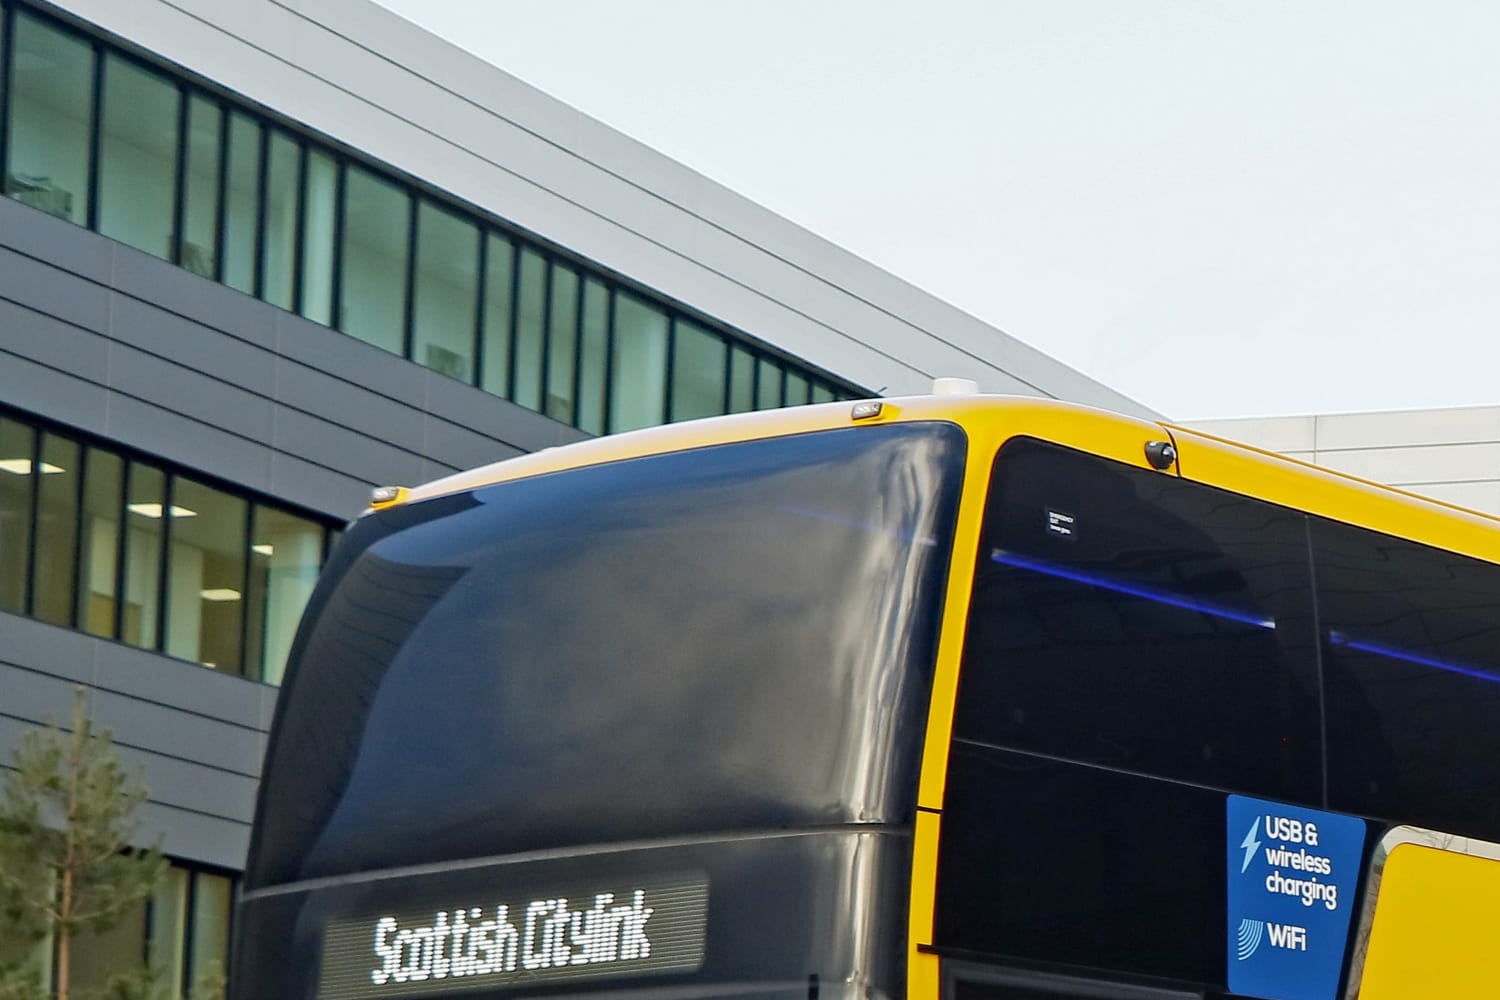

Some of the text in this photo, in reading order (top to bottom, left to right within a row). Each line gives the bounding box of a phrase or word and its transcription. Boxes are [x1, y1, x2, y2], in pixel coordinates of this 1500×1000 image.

[1265, 815, 1318, 846] USB &
[1265, 845, 1331, 875] wireless
[1265, 870, 1337, 910] charging
[371, 889, 654, 985] Scottish Citylink
[1266, 922, 1306, 951] WiFi
